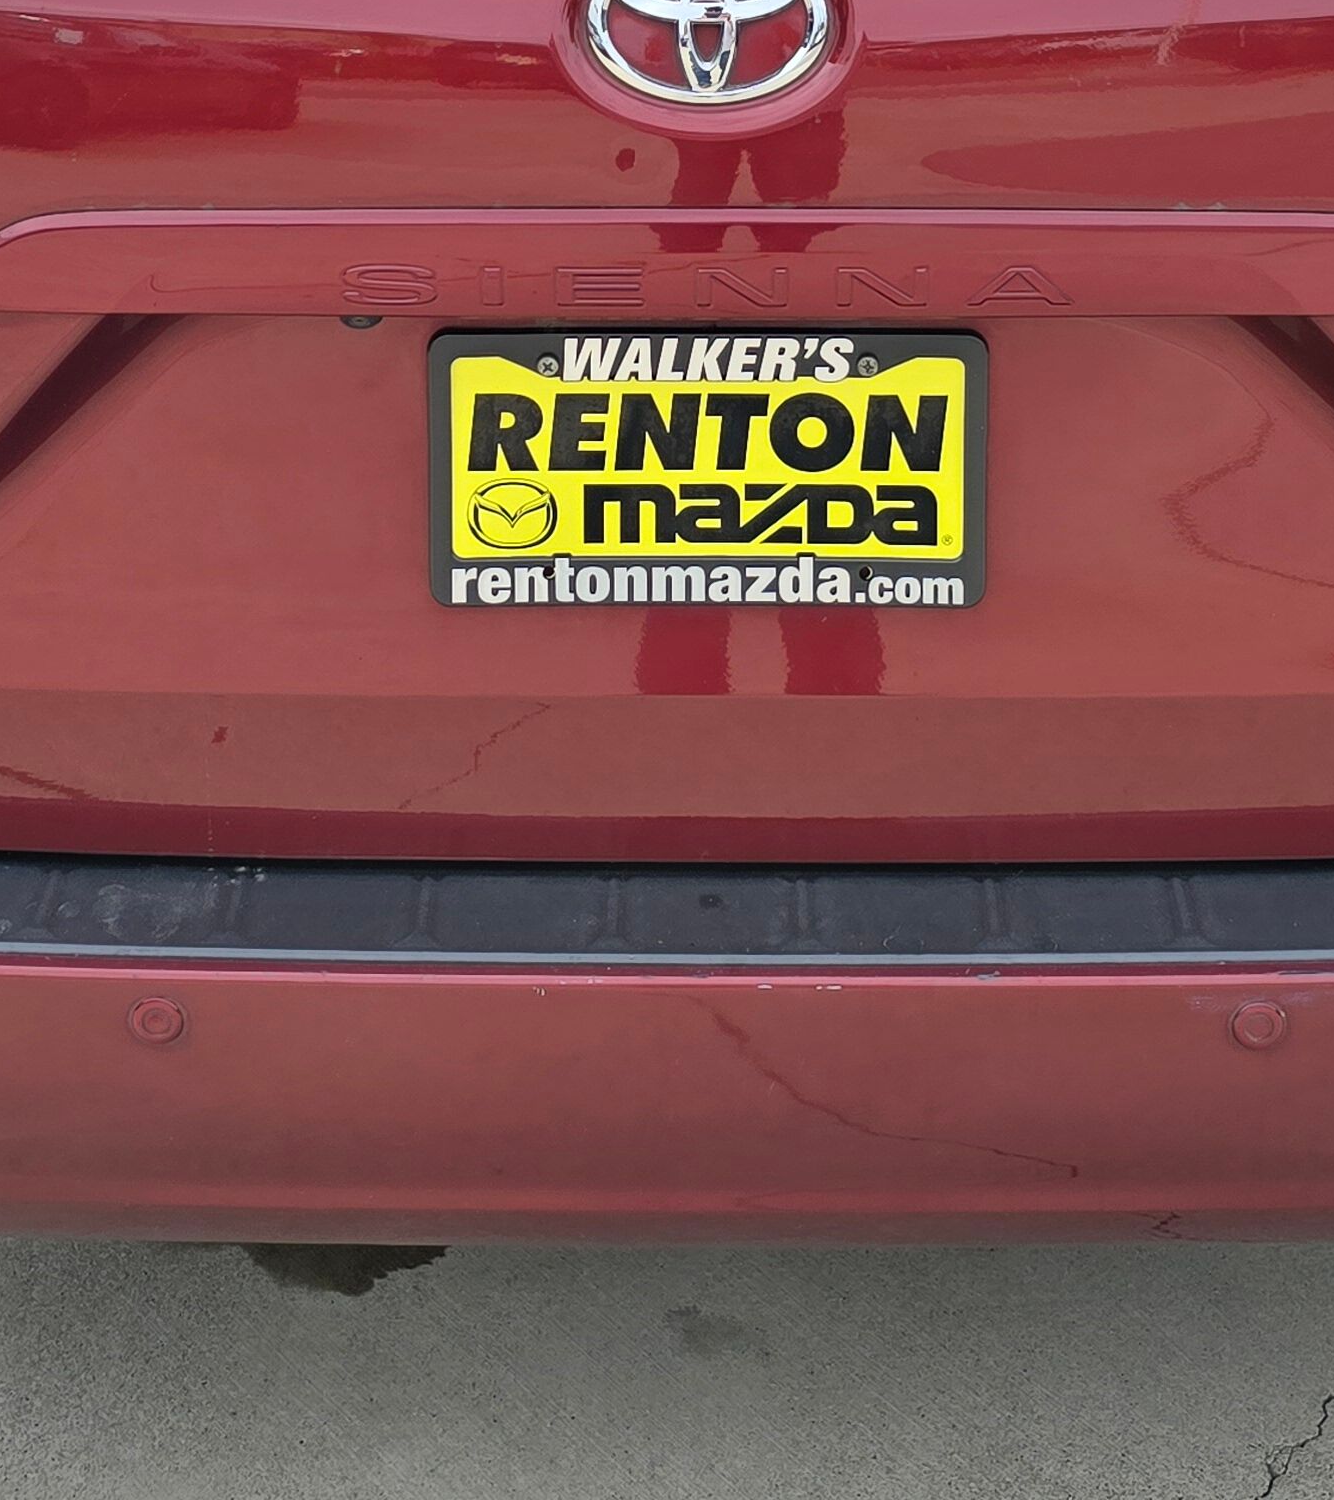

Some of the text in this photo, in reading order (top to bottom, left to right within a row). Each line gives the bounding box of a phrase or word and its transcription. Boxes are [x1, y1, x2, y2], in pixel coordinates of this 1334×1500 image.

[341, 263, 1077, 308] SIENNA
[562, 337, 855, 383] WALKER'S
[468, 392, 948, 472] RENTON
[583, 483, 938, 546] mazda
[451, 556, 965, 606] rentonmazda.com
